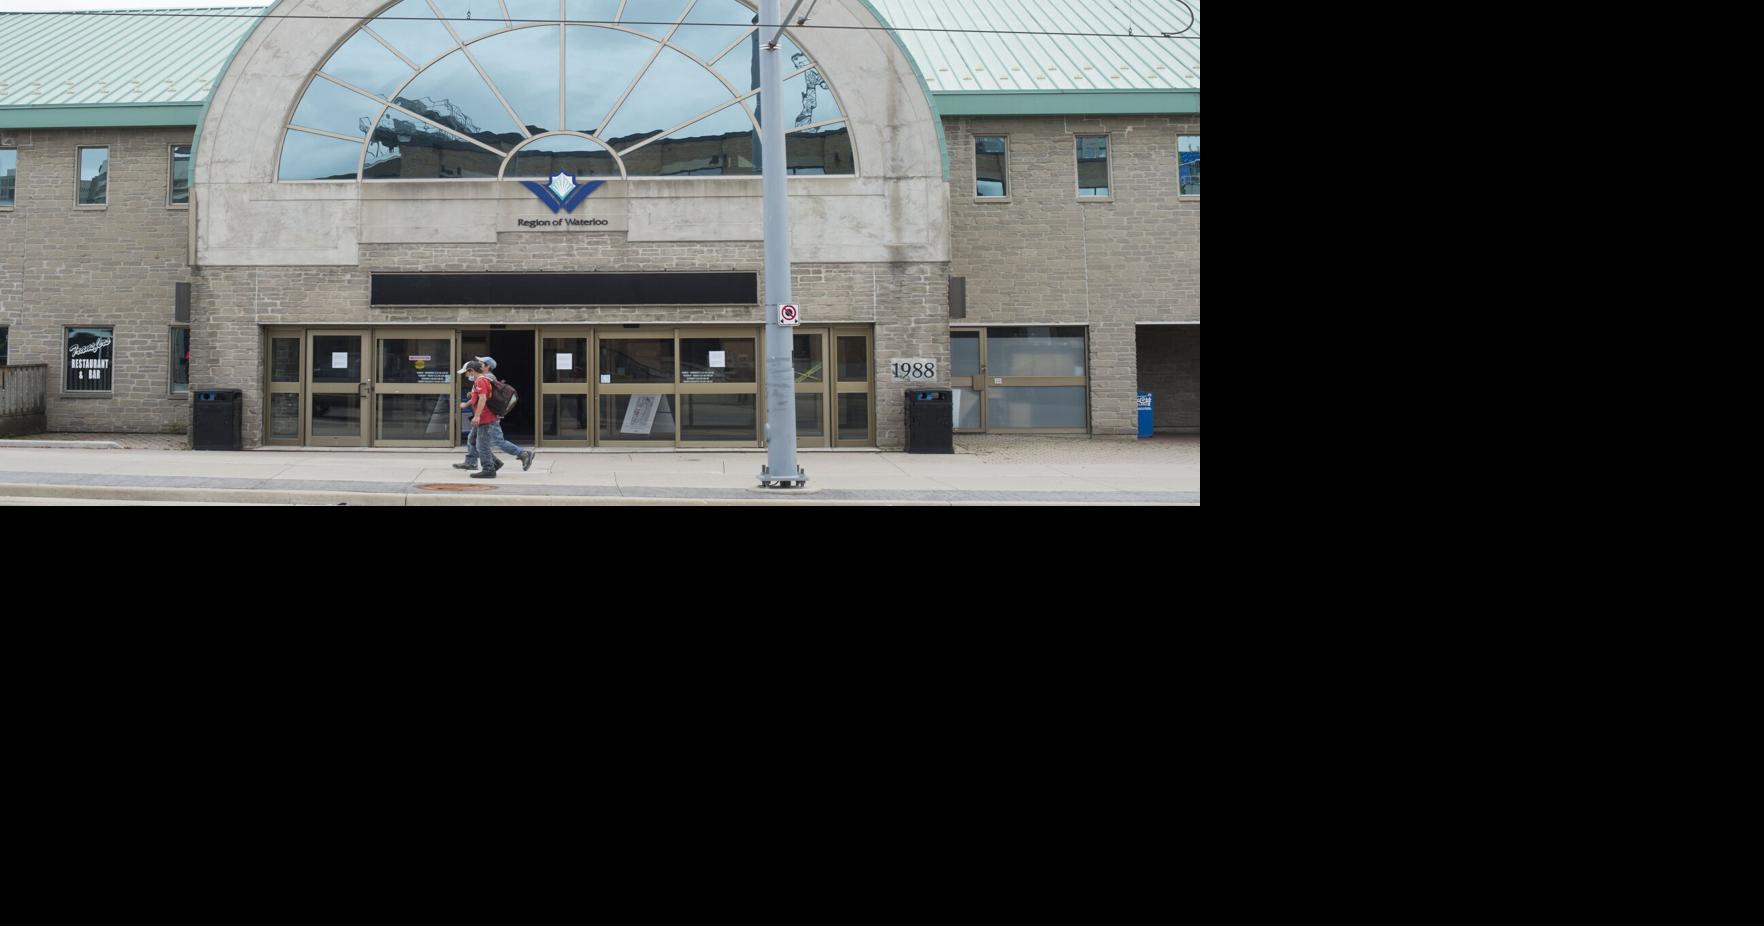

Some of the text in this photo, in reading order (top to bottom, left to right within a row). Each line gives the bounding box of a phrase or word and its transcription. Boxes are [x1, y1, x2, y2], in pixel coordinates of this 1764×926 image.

[517, 218, 609, 228] Region of Waterloo
[71, 359, 108, 368] RESTAURANT
[79, 370, 100, 379] & BAR
[891, 362, 935, 379] 1988
